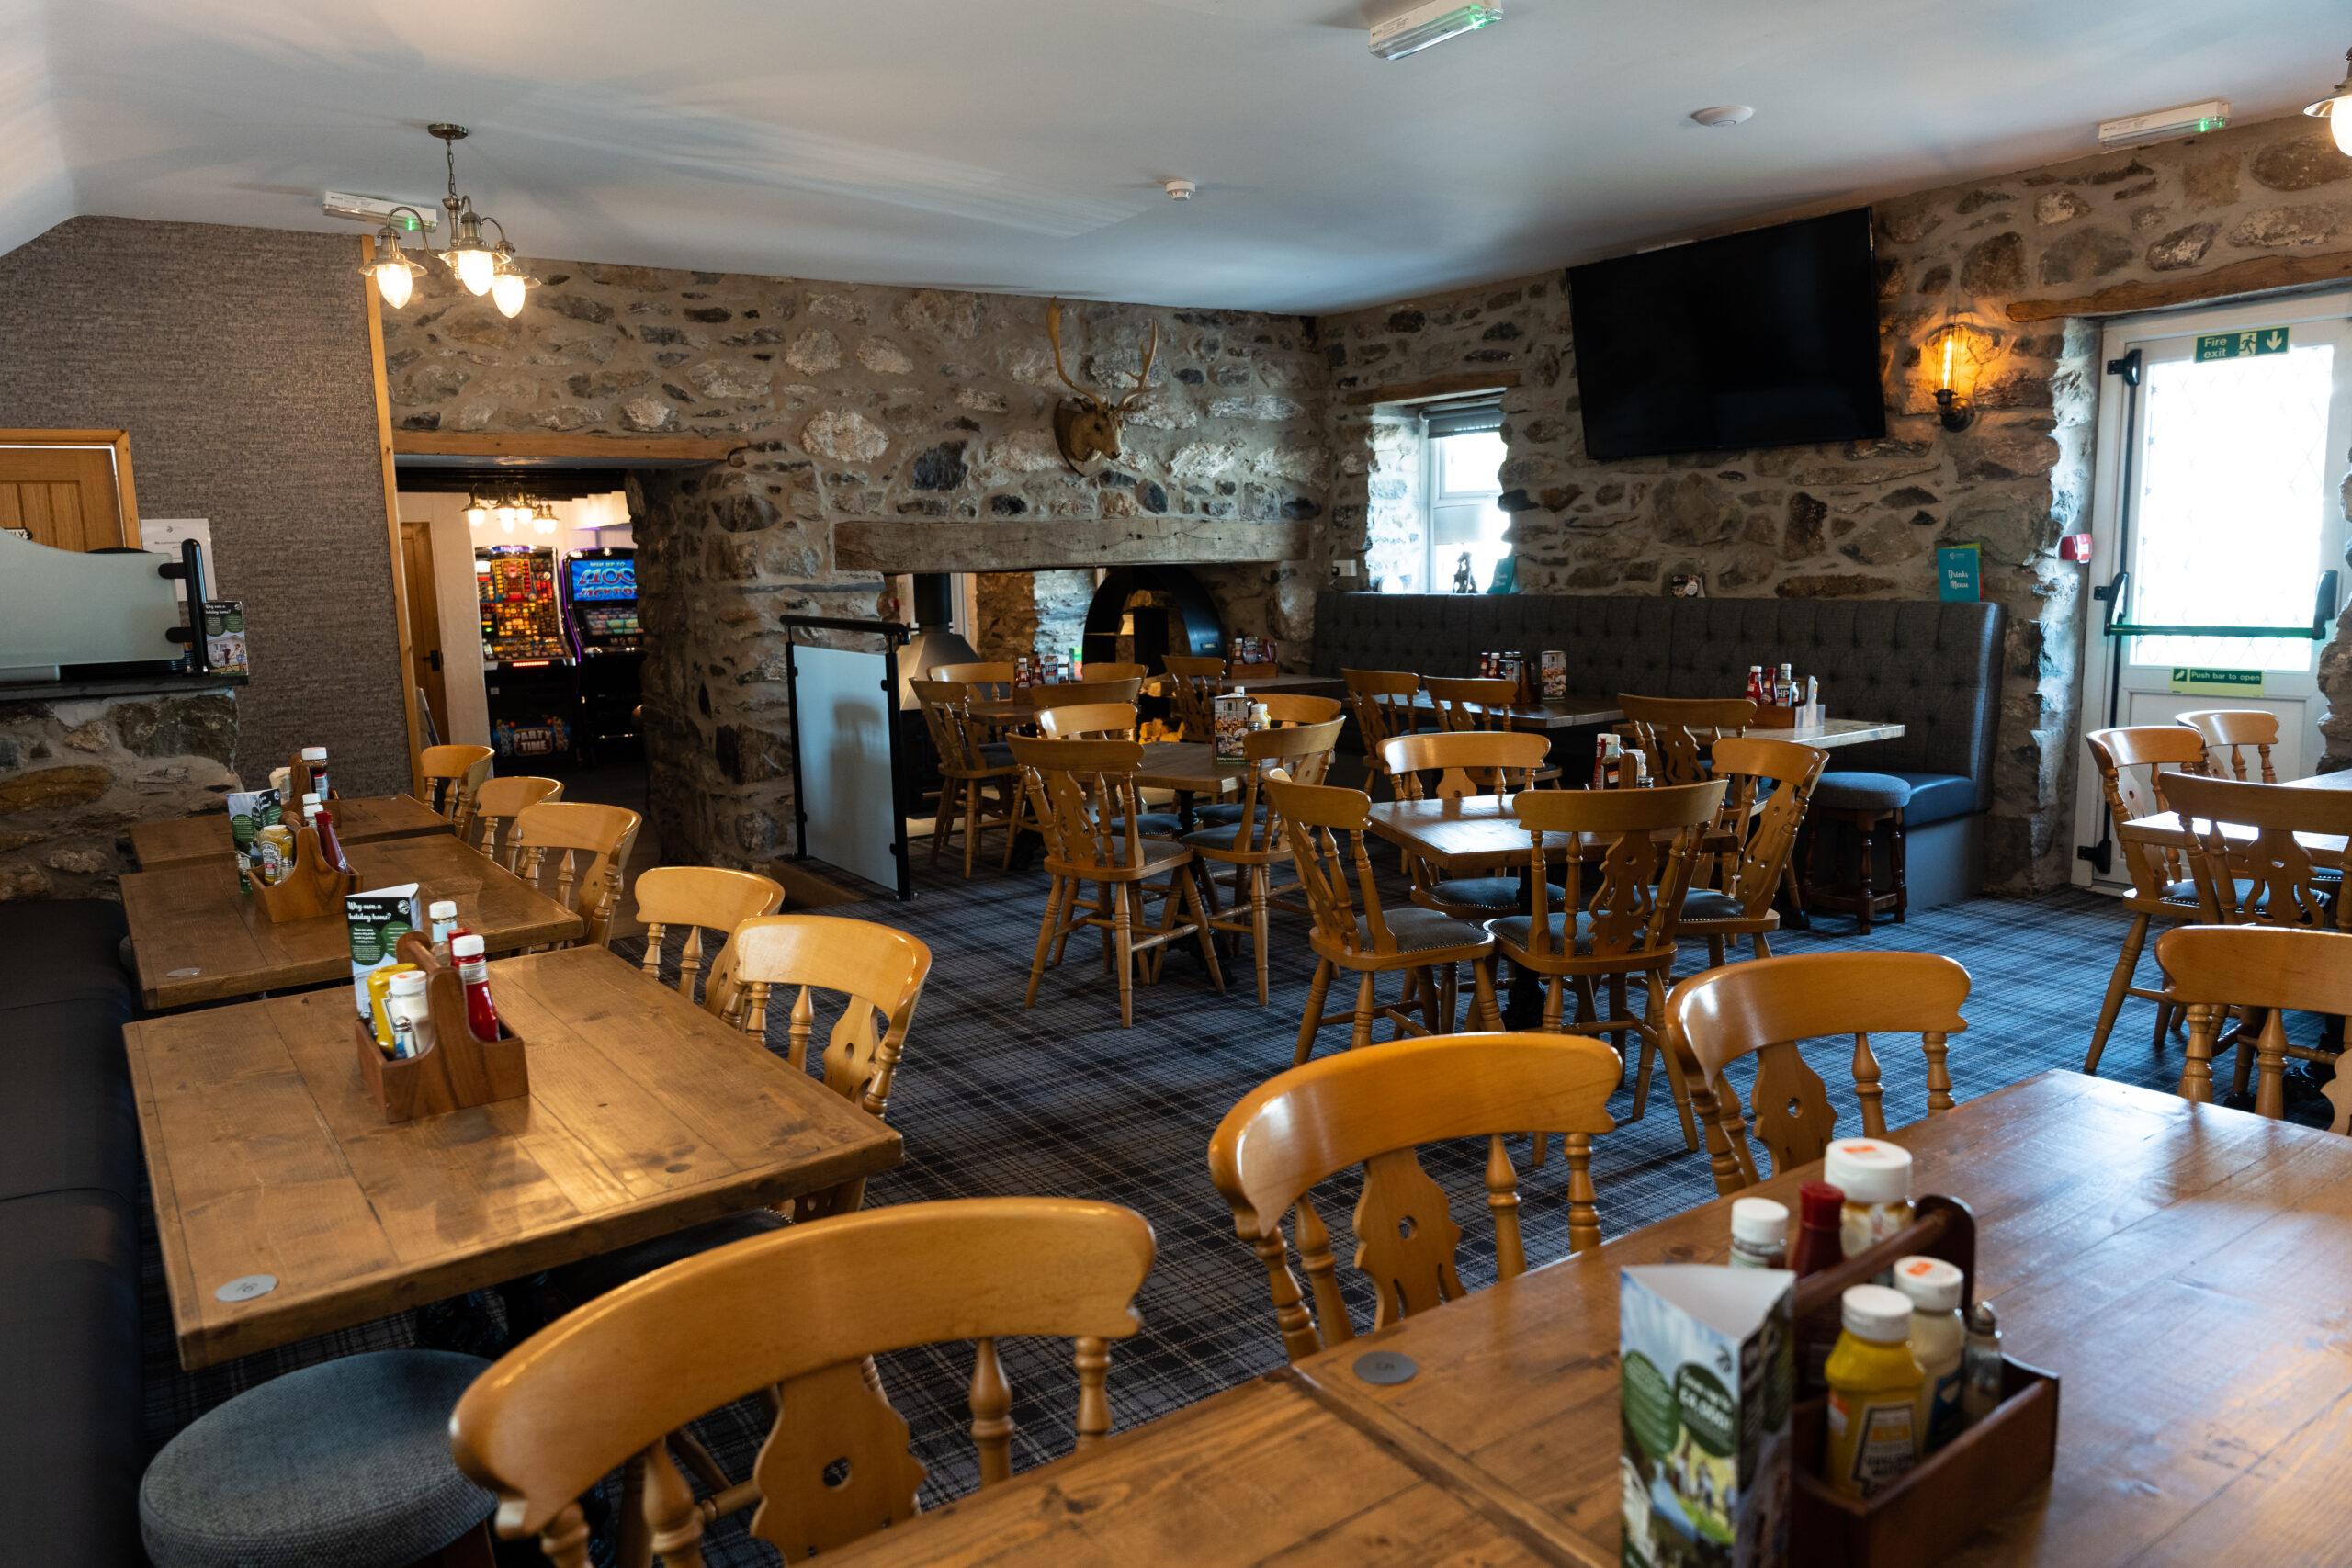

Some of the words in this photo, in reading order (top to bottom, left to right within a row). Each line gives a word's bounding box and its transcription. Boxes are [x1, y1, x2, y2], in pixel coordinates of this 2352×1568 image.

[2204, 337, 2227, 348] Fire
[2203, 347, 2226, 359] exit
[1948, 570, 1969, 580] Drinks
[1949, 580, 1969, 590] Menu
[2240, 674, 2260, 682] open
[1777, 690, 1790, 698] HP
[513, 730, 552, 743] PARTY
[520, 739, 548, 751] TIME
[347, 901, 363, 912] Why
[348, 912, 372, 923] holiday
[372, 912, 392, 920] home?
